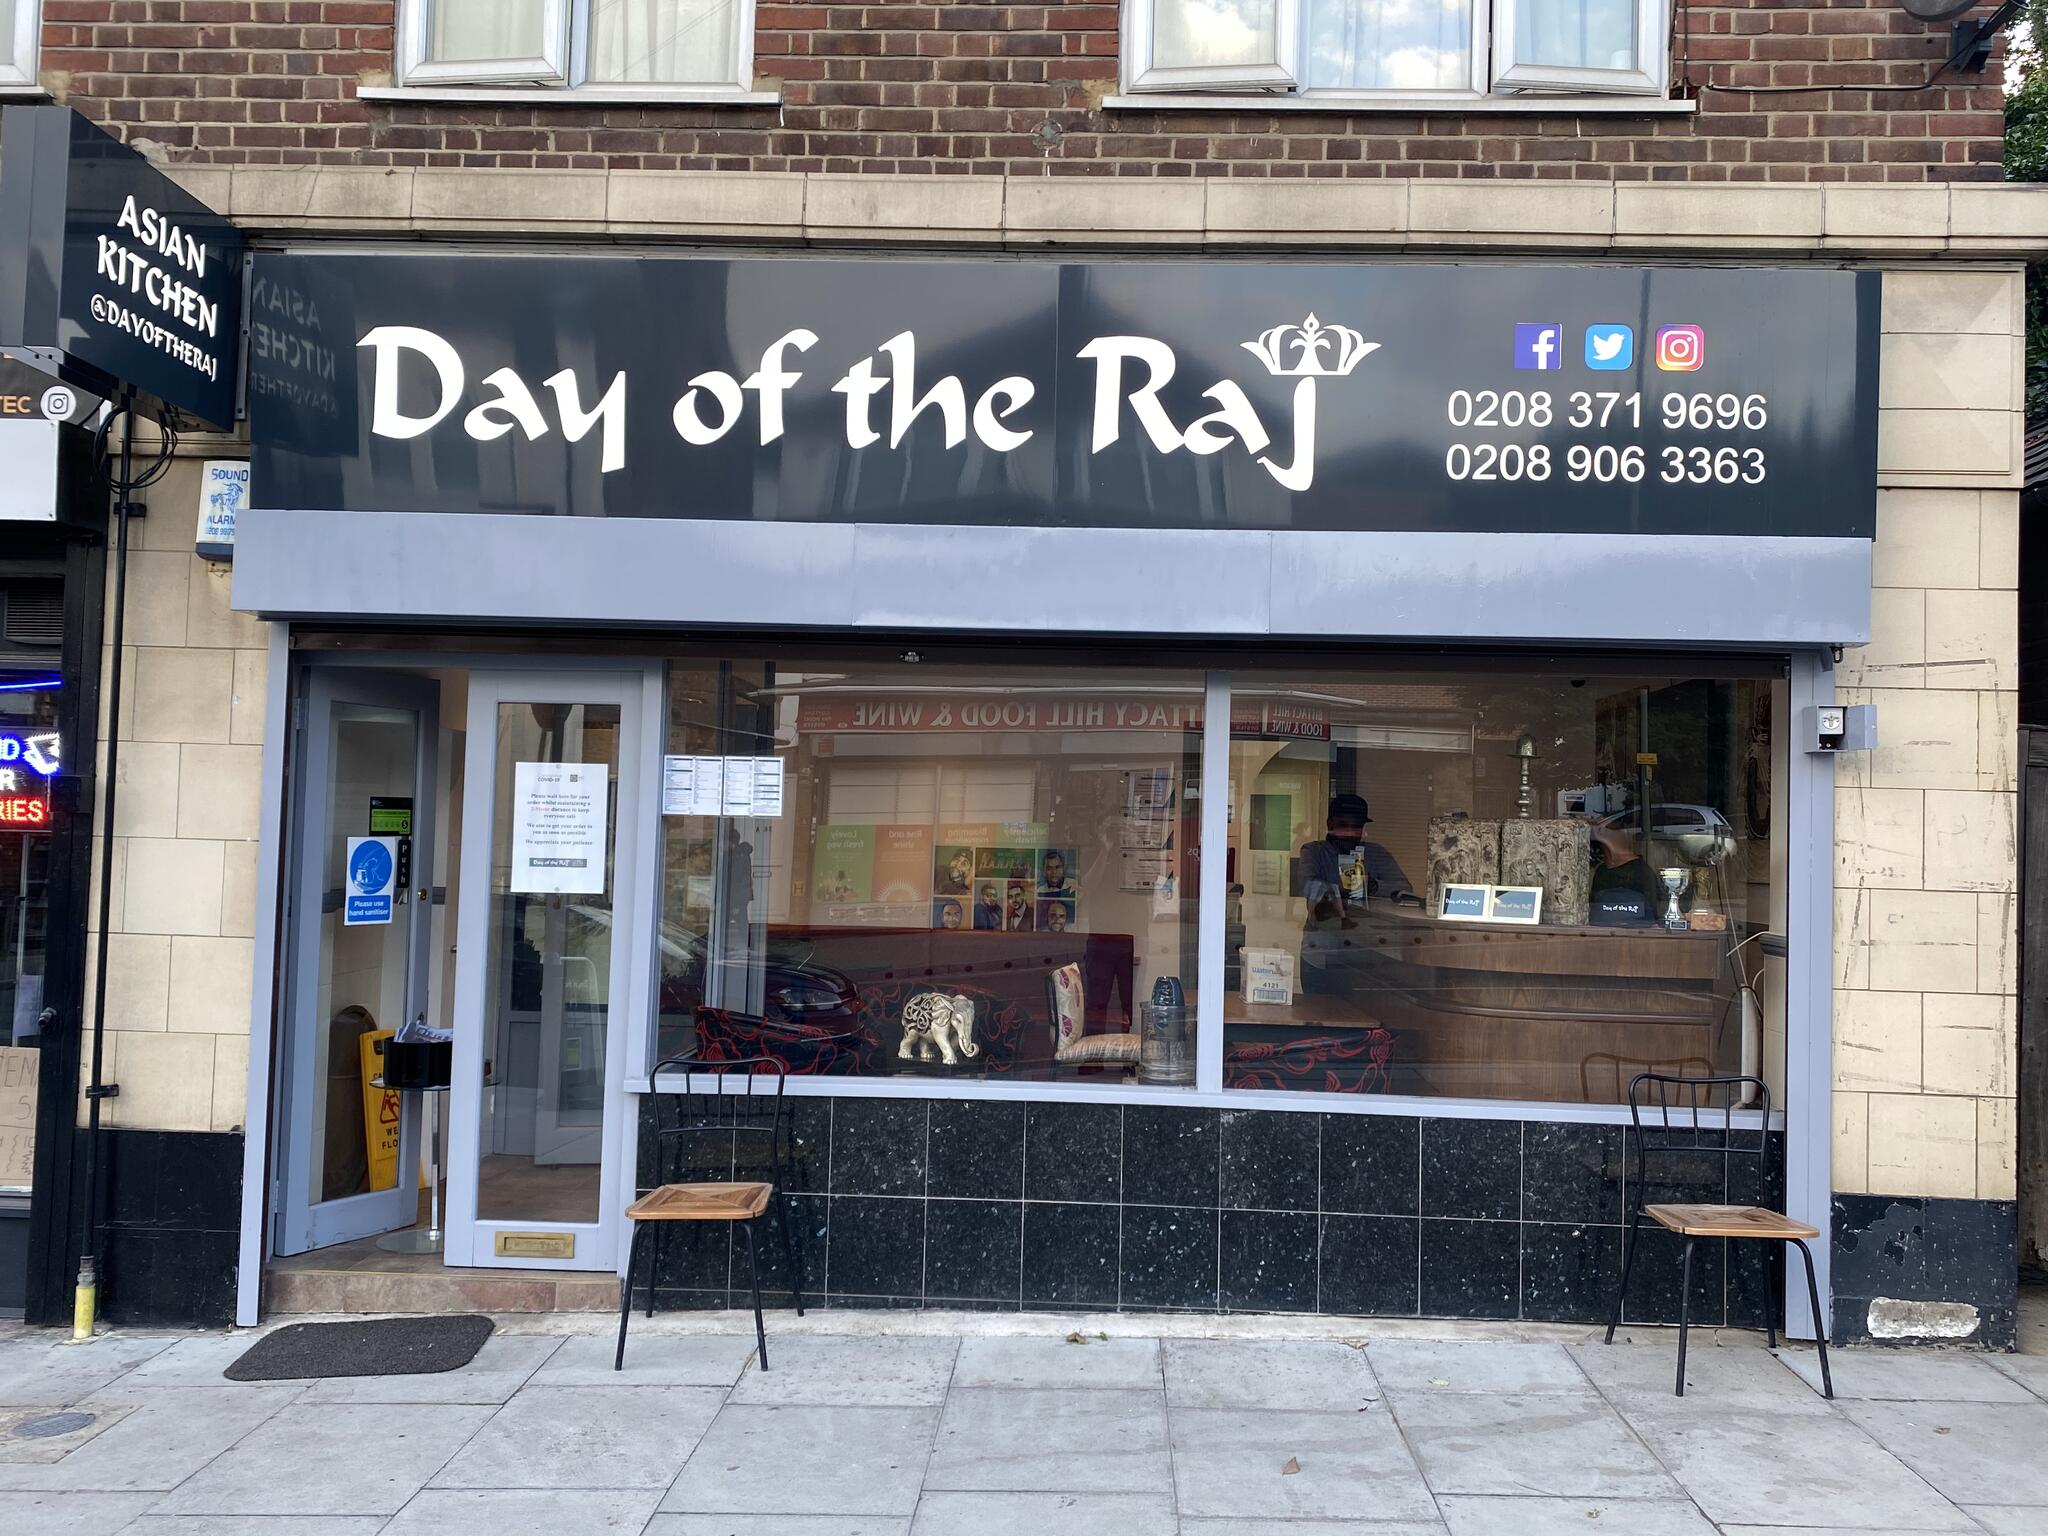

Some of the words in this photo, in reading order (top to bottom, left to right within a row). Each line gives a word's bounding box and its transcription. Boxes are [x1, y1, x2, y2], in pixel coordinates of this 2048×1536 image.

[117, 195, 206, 278] ASIAN
[97, 234, 218, 338] KITCHEN
[90, 293, 218, 382] @DAYOFTHERAJ
[0, 396, 31, 414] EC
[356, 326, 626, 473] Day
[673, 328, 819, 446] of
[830, 330, 1035, 452] the
[1075, 335, 1317, 491] Raj
[1447, 390, 1553, 428] 0208
[1567, 391, 1642, 428] 371
[1661, 392, 1768, 430] 9696
[211, 467, 249, 482] SOUND
[1445, 443, 1552, 481] 0208
[1566, 445, 1646, 482] 906
[1660, 446, 1766, 484] 3363
